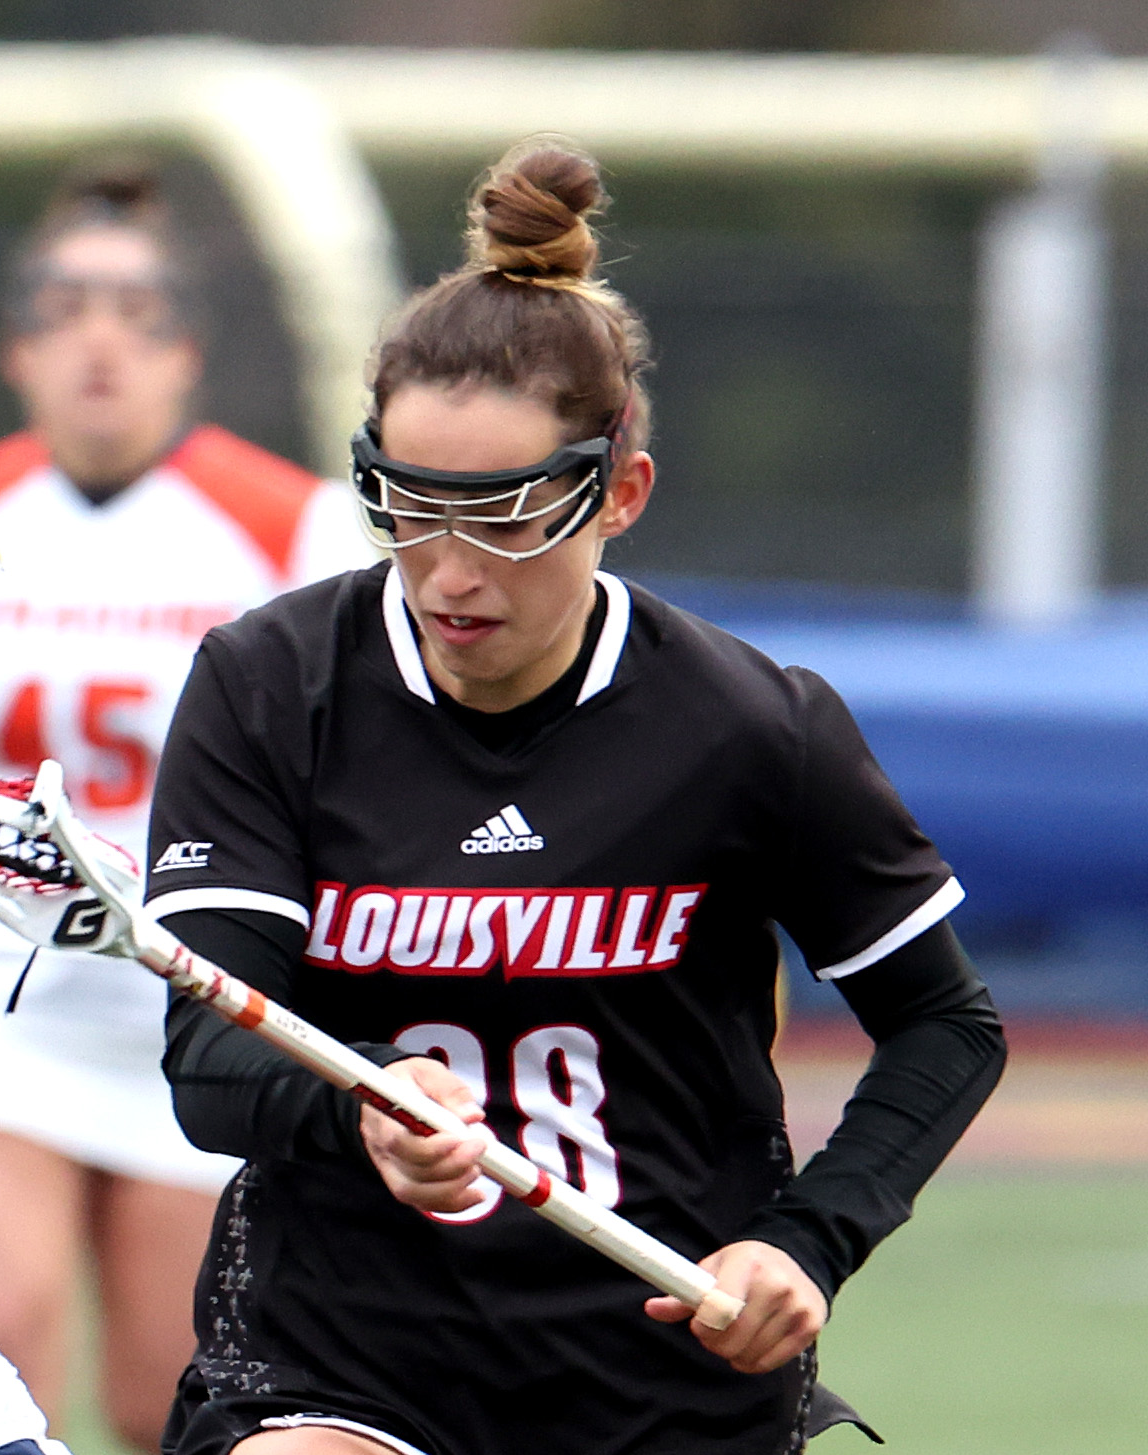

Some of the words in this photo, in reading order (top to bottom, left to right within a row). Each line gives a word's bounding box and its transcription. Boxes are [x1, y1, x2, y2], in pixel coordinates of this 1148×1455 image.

[154, 841, 214, 870] ACC
[460, 834, 544, 855] adidas
[303, 882, 707, 978] LOUISVILLE
